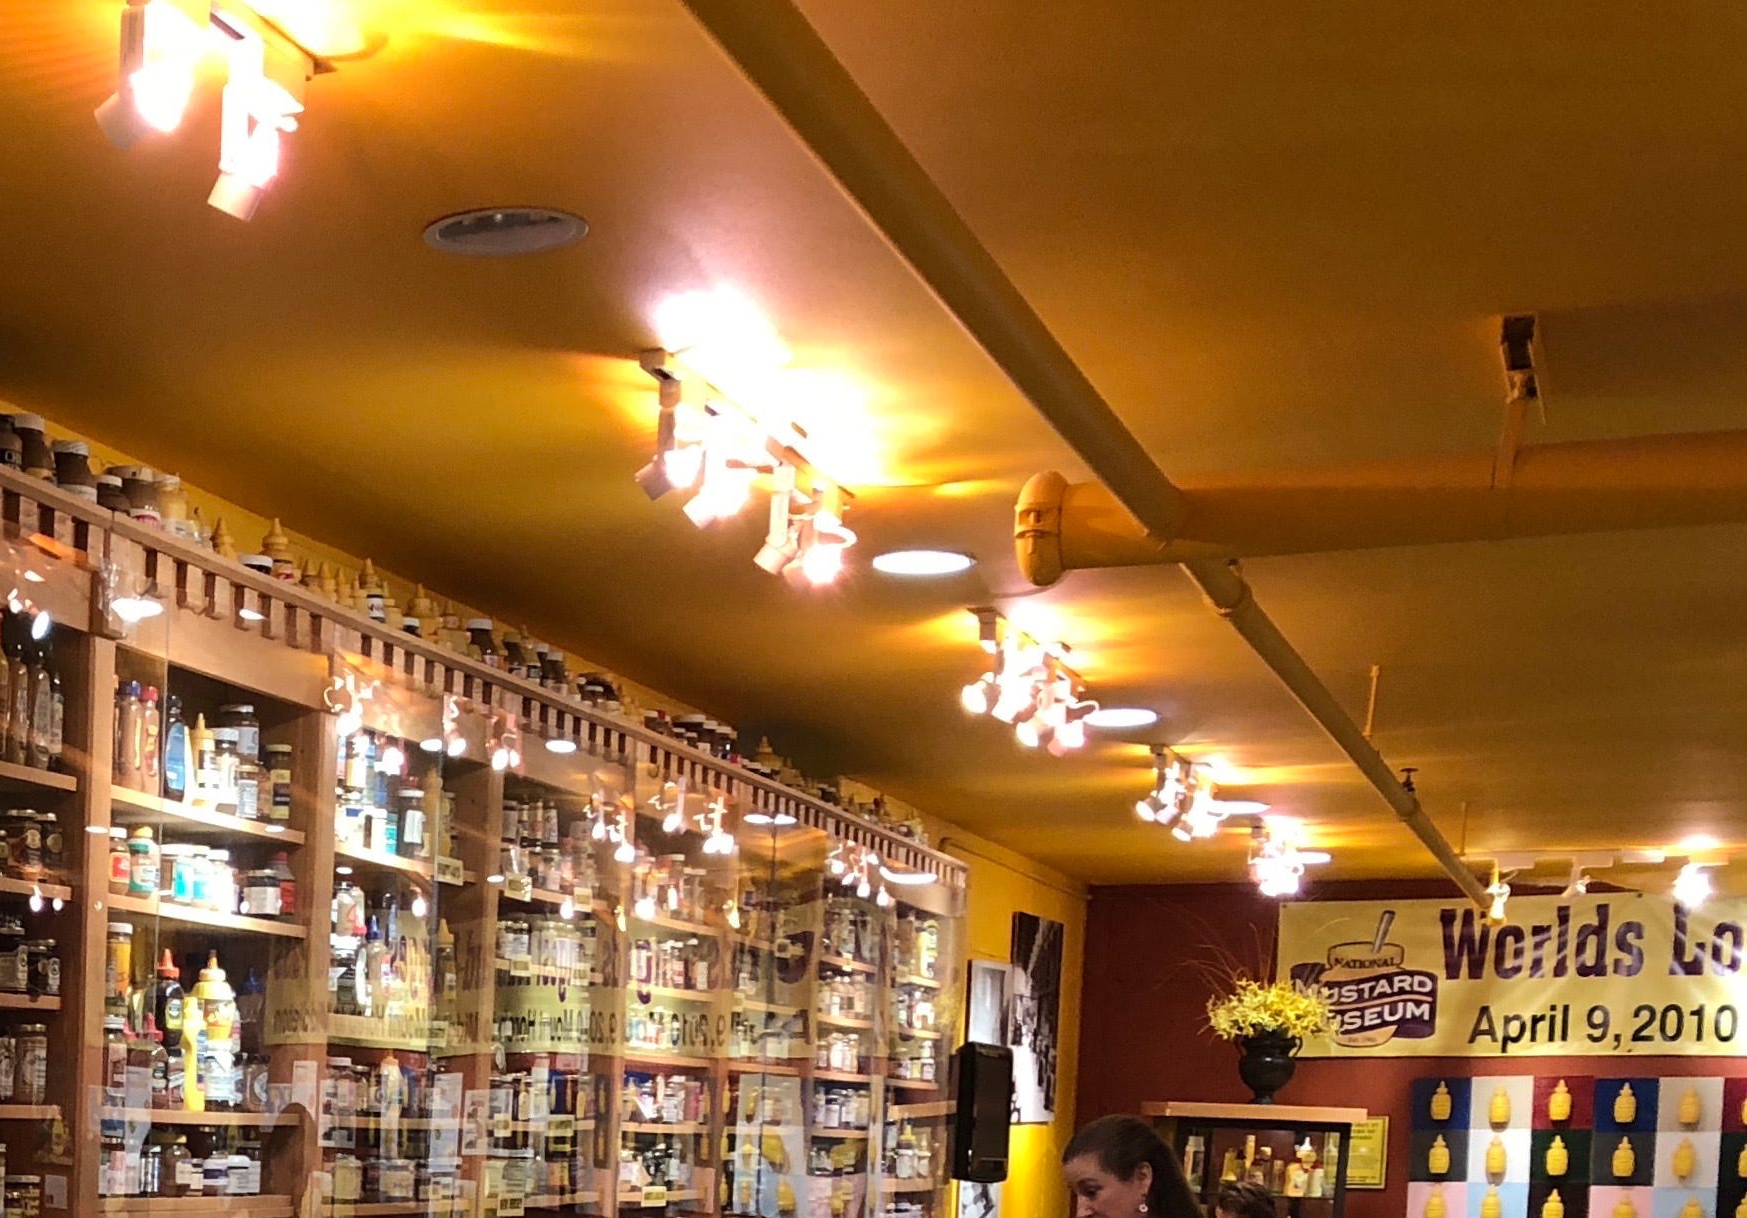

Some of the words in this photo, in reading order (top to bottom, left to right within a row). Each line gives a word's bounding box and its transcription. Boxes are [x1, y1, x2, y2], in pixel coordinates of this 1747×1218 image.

[1334, 957, 1398, 969] NATIONAL
[1440, 903, 1644, 981] Worlds
[1468, 1004, 1570, 1053] April
